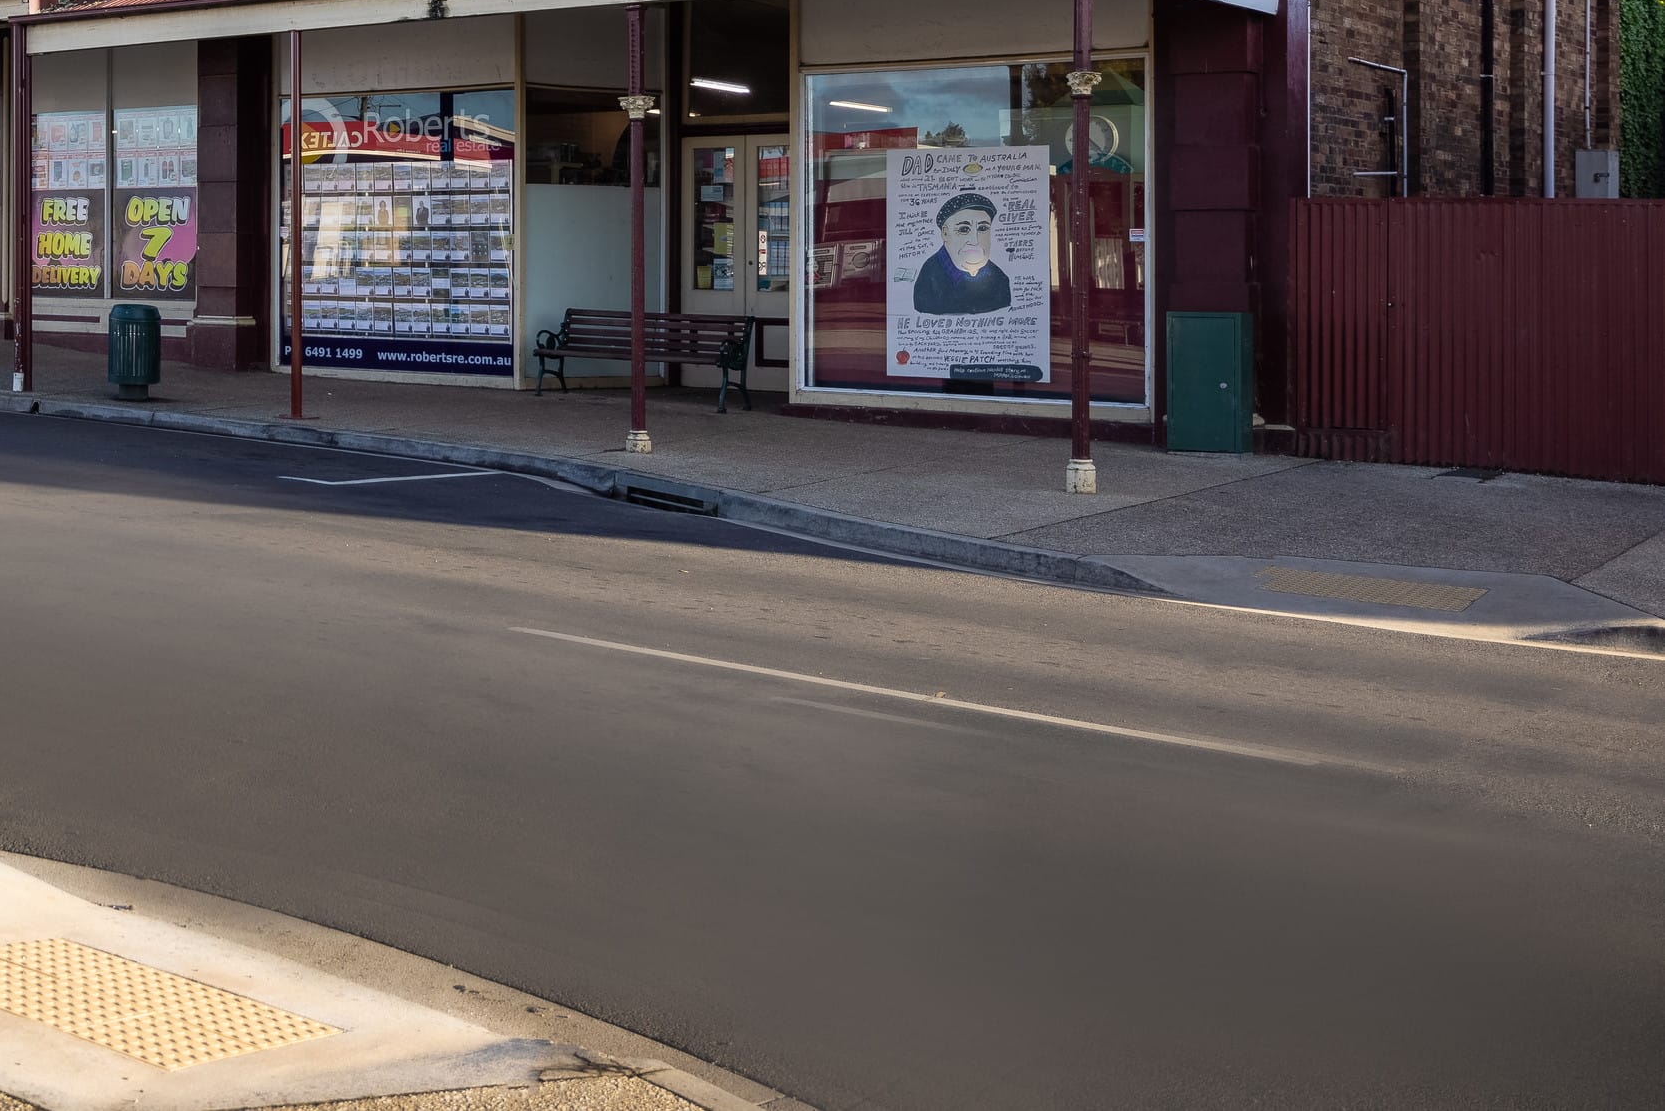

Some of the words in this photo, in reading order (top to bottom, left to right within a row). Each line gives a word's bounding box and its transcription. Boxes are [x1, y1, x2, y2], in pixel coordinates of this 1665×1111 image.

[363, 108, 490, 144] Roberts
[426, 140, 452, 153] real
[456, 140, 501, 153] estate
[902, 153, 934, 176] DAD
[937, 154, 962, 163] CAME
[968, 154, 978, 162] TO
[979, 152, 1027, 162] AUSTRALIA
[41, 197, 89, 226] FREE
[125, 196, 190, 226] OPEN
[909, 198, 921, 206] 36
[1008, 199, 1036, 210] REAL
[998, 211, 1035, 223] GIVER
[36, 231, 93, 260] HOME
[141, 225, 173, 261] 7
[32, 264, 101, 289] DELIVERY
[121, 261, 188, 290] DAYS
[897, 317, 910, 329] HE
[916, 316, 953, 329] LOVED
[956, 316, 1004, 329] NOTHING
[1008, 316, 1038, 326] MORE
[305, 346, 332, 358] 6491
[335, 348, 363, 360] 1499
[377, 350, 512, 366] www.robertsre.com.au
[969, 355, 995, 363] PATCH
